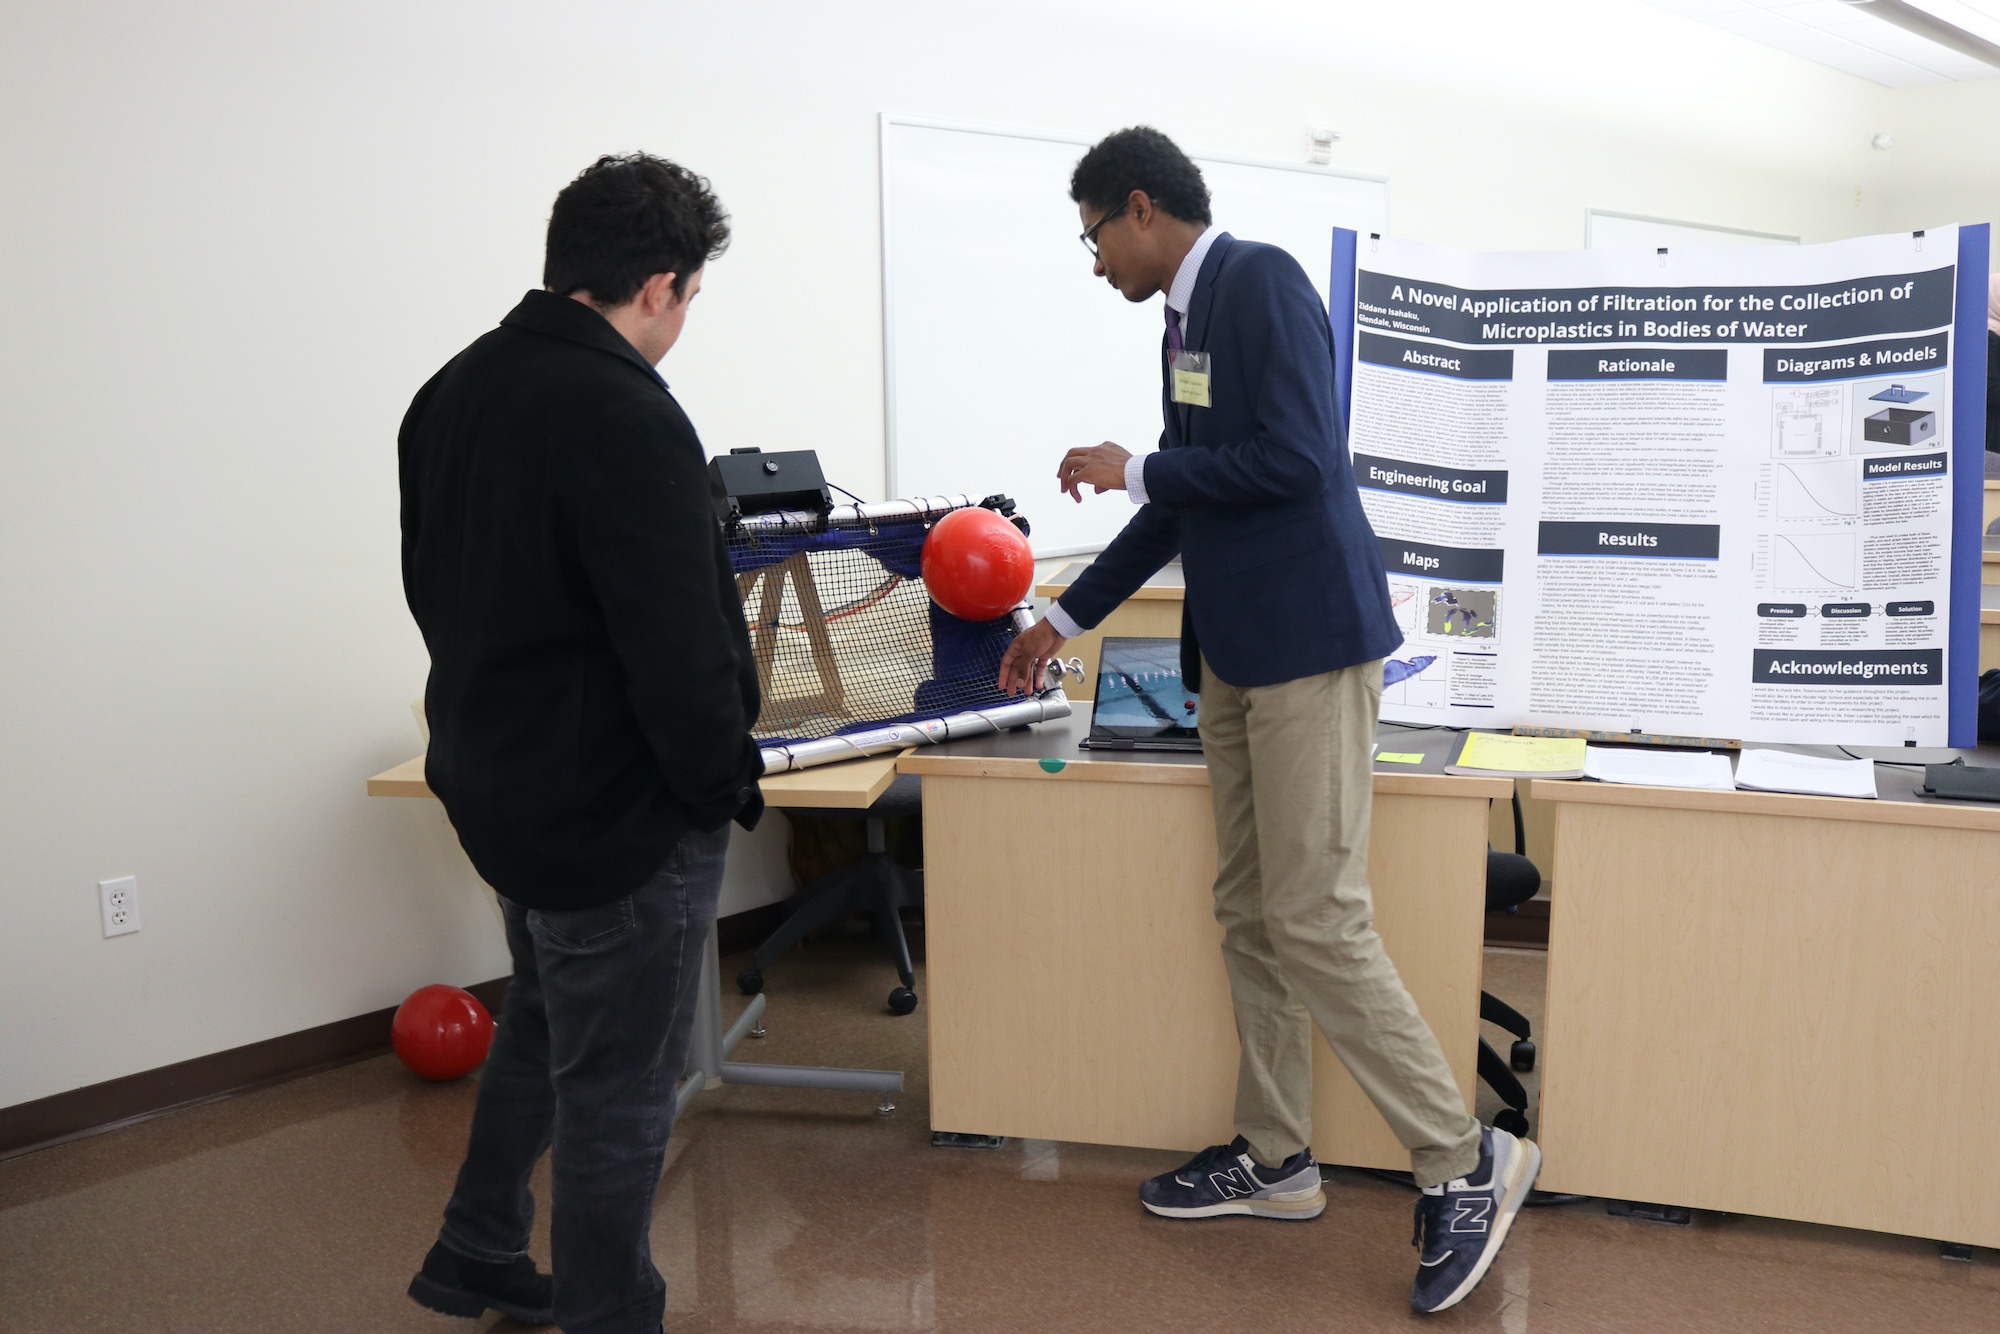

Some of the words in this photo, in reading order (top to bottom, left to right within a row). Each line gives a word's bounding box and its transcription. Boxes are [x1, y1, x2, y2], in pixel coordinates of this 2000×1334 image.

[1391, 284, 1404, 301] A
[1408, 287, 1458, 311] Novel
[1460, 297, 1572, 319] Application
[1577, 295, 1599, 312] of
[1603, 294, 1697, 312] Filtration
[1702, 294, 1734, 312] for
[1738, 295, 1774, 311] the
[1779, 287, 1884, 311] Collection
[1889, 281, 1915, 300] of
[1359, 301, 1388, 315] Ziddane
[1388, 307, 1420, 321] Isahaku,
[1359, 313, 1392, 328] Glendale,
[1392, 320, 1431, 334] Wisconsin
[1482, 322, 1613, 343] Microplastics
[1618, 320, 1637, 337] in
[1643, 320, 1712, 338] Bodies
[1716, 320, 1739, 338] of
[1743, 321, 1808, 338] Water
[1403, 348, 1461, 371] Abstract
[1598, 358, 1676, 373] Rationale
[1776, 356, 1855, 376] Diagrams
[1859, 352, 1872, 366] &
[1876, 346, 1937, 365] Models
[1869, 462, 1901, 474] Model
[1904, 460, 1943, 471] Results
[1369, 466, 1449, 494] Engineering
[1452, 479, 1487, 493] Goal
[1598, 532, 1658, 547] Results
[1403, 551, 1440, 571] Maps
[1769, 660, 1928, 679] Acknowledgments
[1518, 727, 1578, 738] NICOLET
[1590, 732, 1618, 741] ART
[1630, 734, 1653, 744] FOR
[1660, 736, 1728, 748] TEACHING
[1209, 1167, 1255, 1200] N
